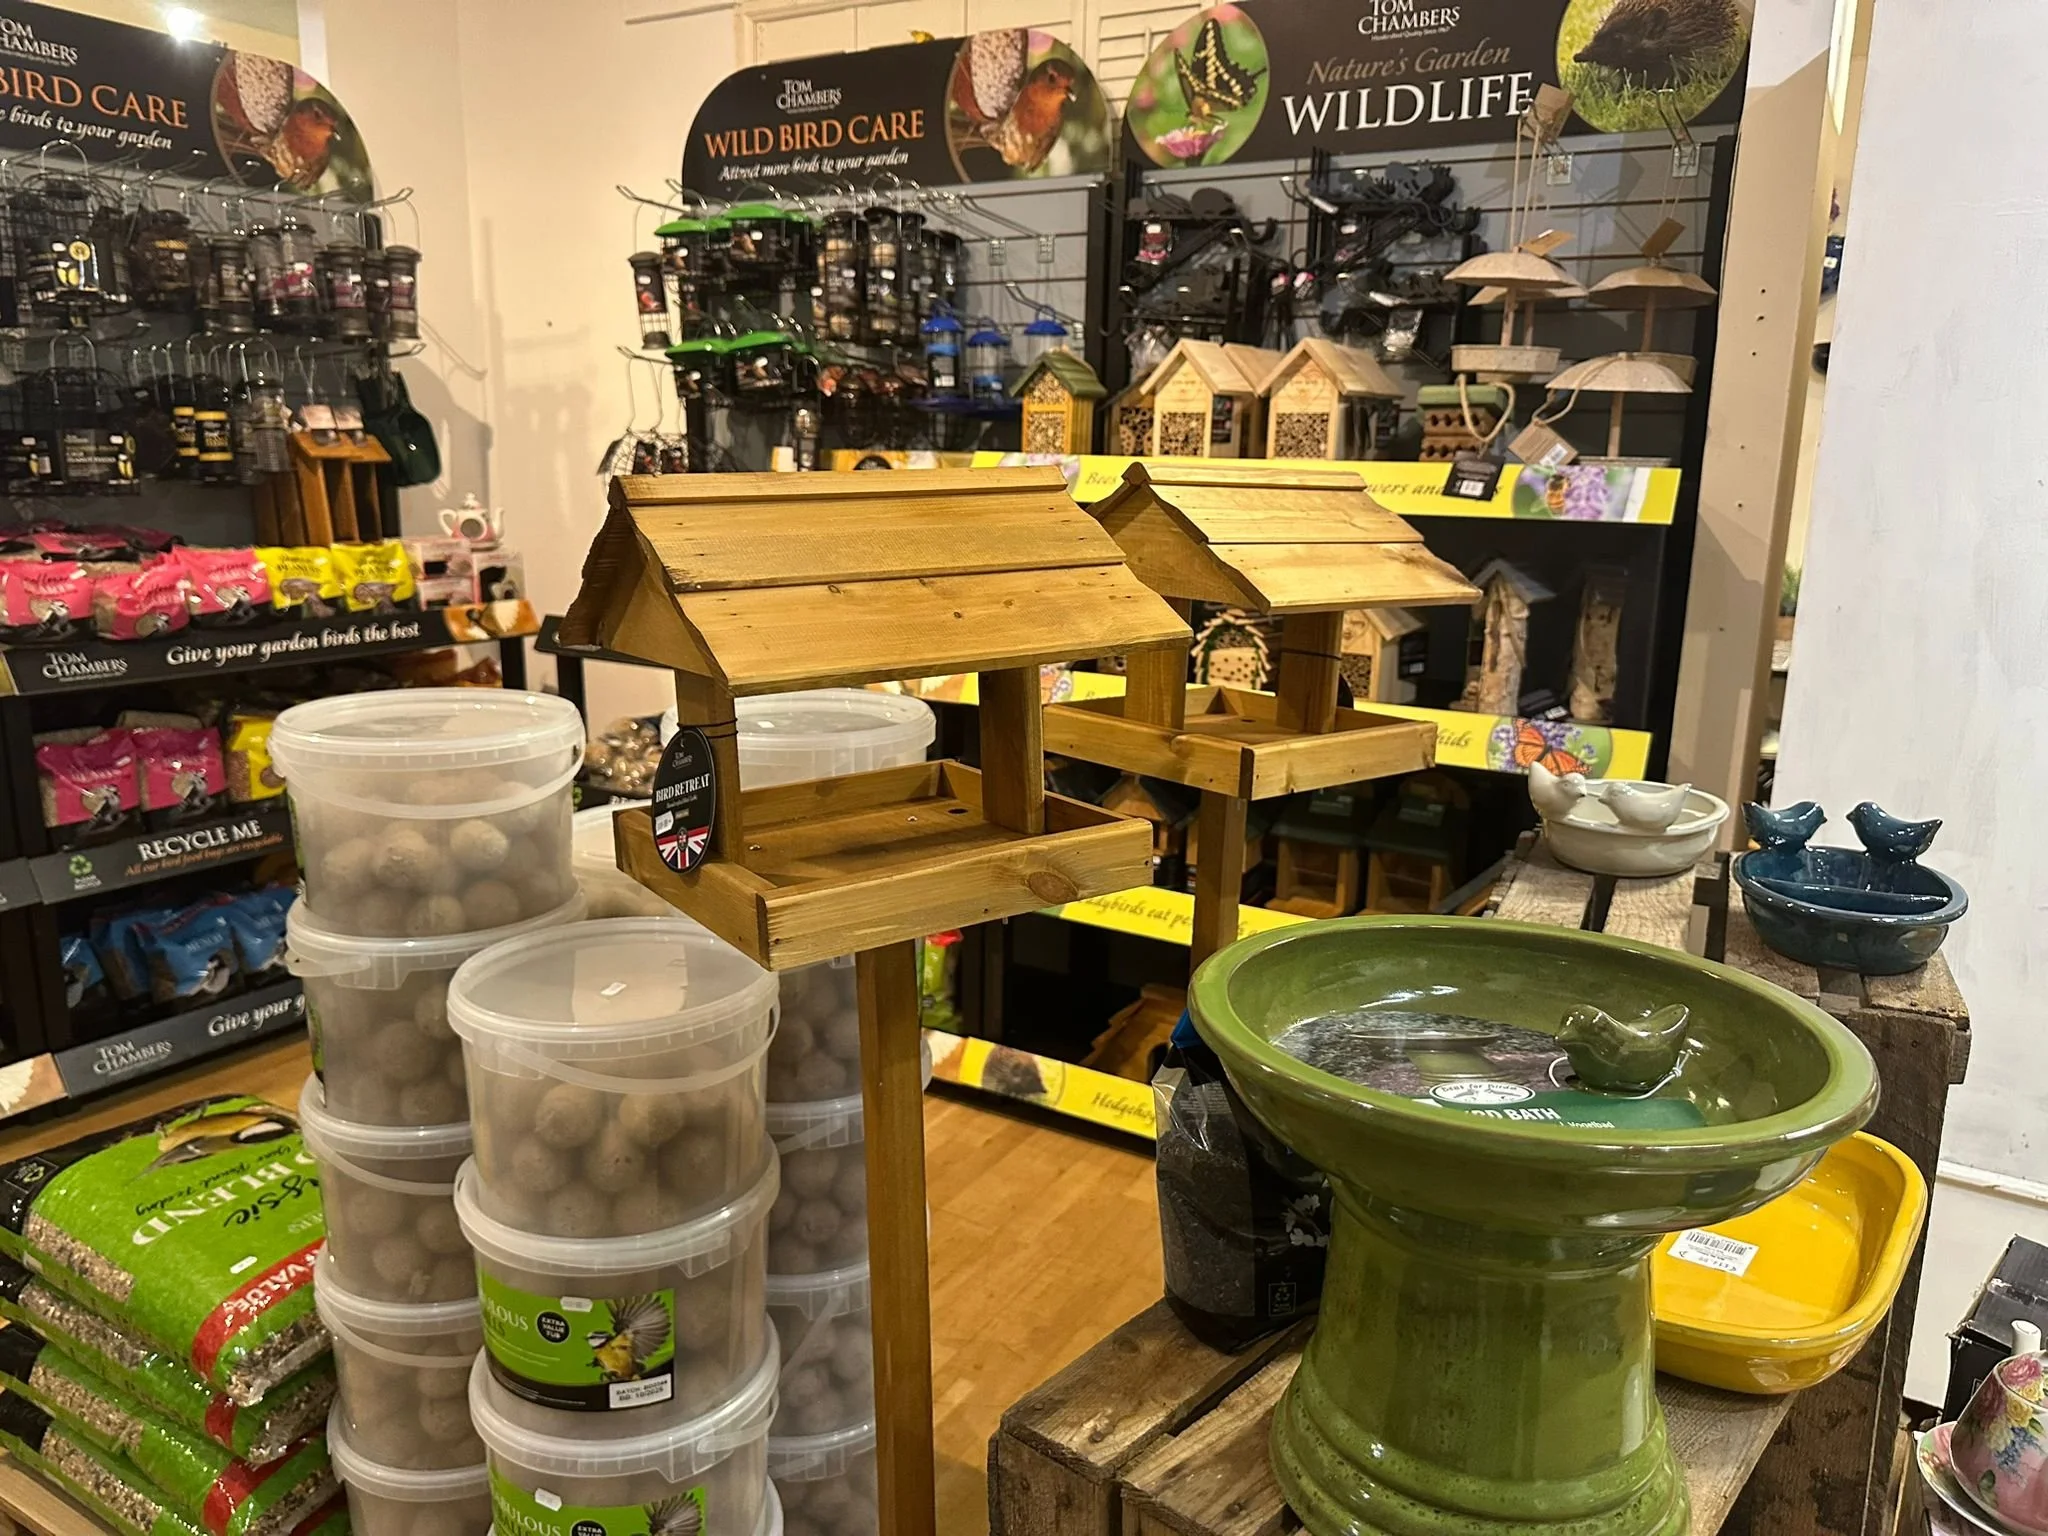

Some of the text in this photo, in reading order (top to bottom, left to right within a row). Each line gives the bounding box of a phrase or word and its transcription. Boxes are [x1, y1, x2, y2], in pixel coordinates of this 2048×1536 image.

[1358, 6, 1461, 35] CHAMBERS
[1369, 0, 1414, 16] TOM
[0, 17, 34, 40] OM
[0, 37, 78, 65] HAMBERS
[1306, 37, 1511, 85] Nature's Garden
[776, 88, 842, 110] CHAMBERS
[783, 79, 813, 95] TOM
[91, 85, 189, 129] CARE
[1281, 71, 1534, 136] WILDLIFE
[9, 105, 53, 130] birds
[56, 116, 74, 133] to
[74, 122, 116, 141] your
[115, 130, 173, 149] garden
[704, 109, 925, 159] WILD BIRD CARE
[719, 147, 909, 182] Attract more birds to your garden
[1085, 471, 1117, 485] Bees
[1367, 484, 1406, 495] wers
[167, 620, 420, 668] Give your garden birds the best
[42, 658, 128, 679] CHAMBERS
[46, 652, 88, 665] TOM
[655, 773, 711, 803] BIRD RETREAT
[137, 819, 264, 861] RECYCLE ME
[1080, 897, 1145, 915] adybirds
[1147, 909, 1170, 921] eat
[207, 1010, 250, 1037] Give
[251, 997, 292, 1031] your
[92, 1041, 173, 1075] CHAMBERS
[97, 1040, 135, 1060] TOM
[1503, 1108, 1562, 1121] BATH
[133, 1162, 296, 1245] BLEND
[135, 1186, 197, 1217] Feeding
[541, 1316, 566, 1327] EXTRA
[543, 1324, 565, 1333] VALUE
[546, 1331, 561, 1339] TUB
[577, 1525, 602, 1534] EXTRA
